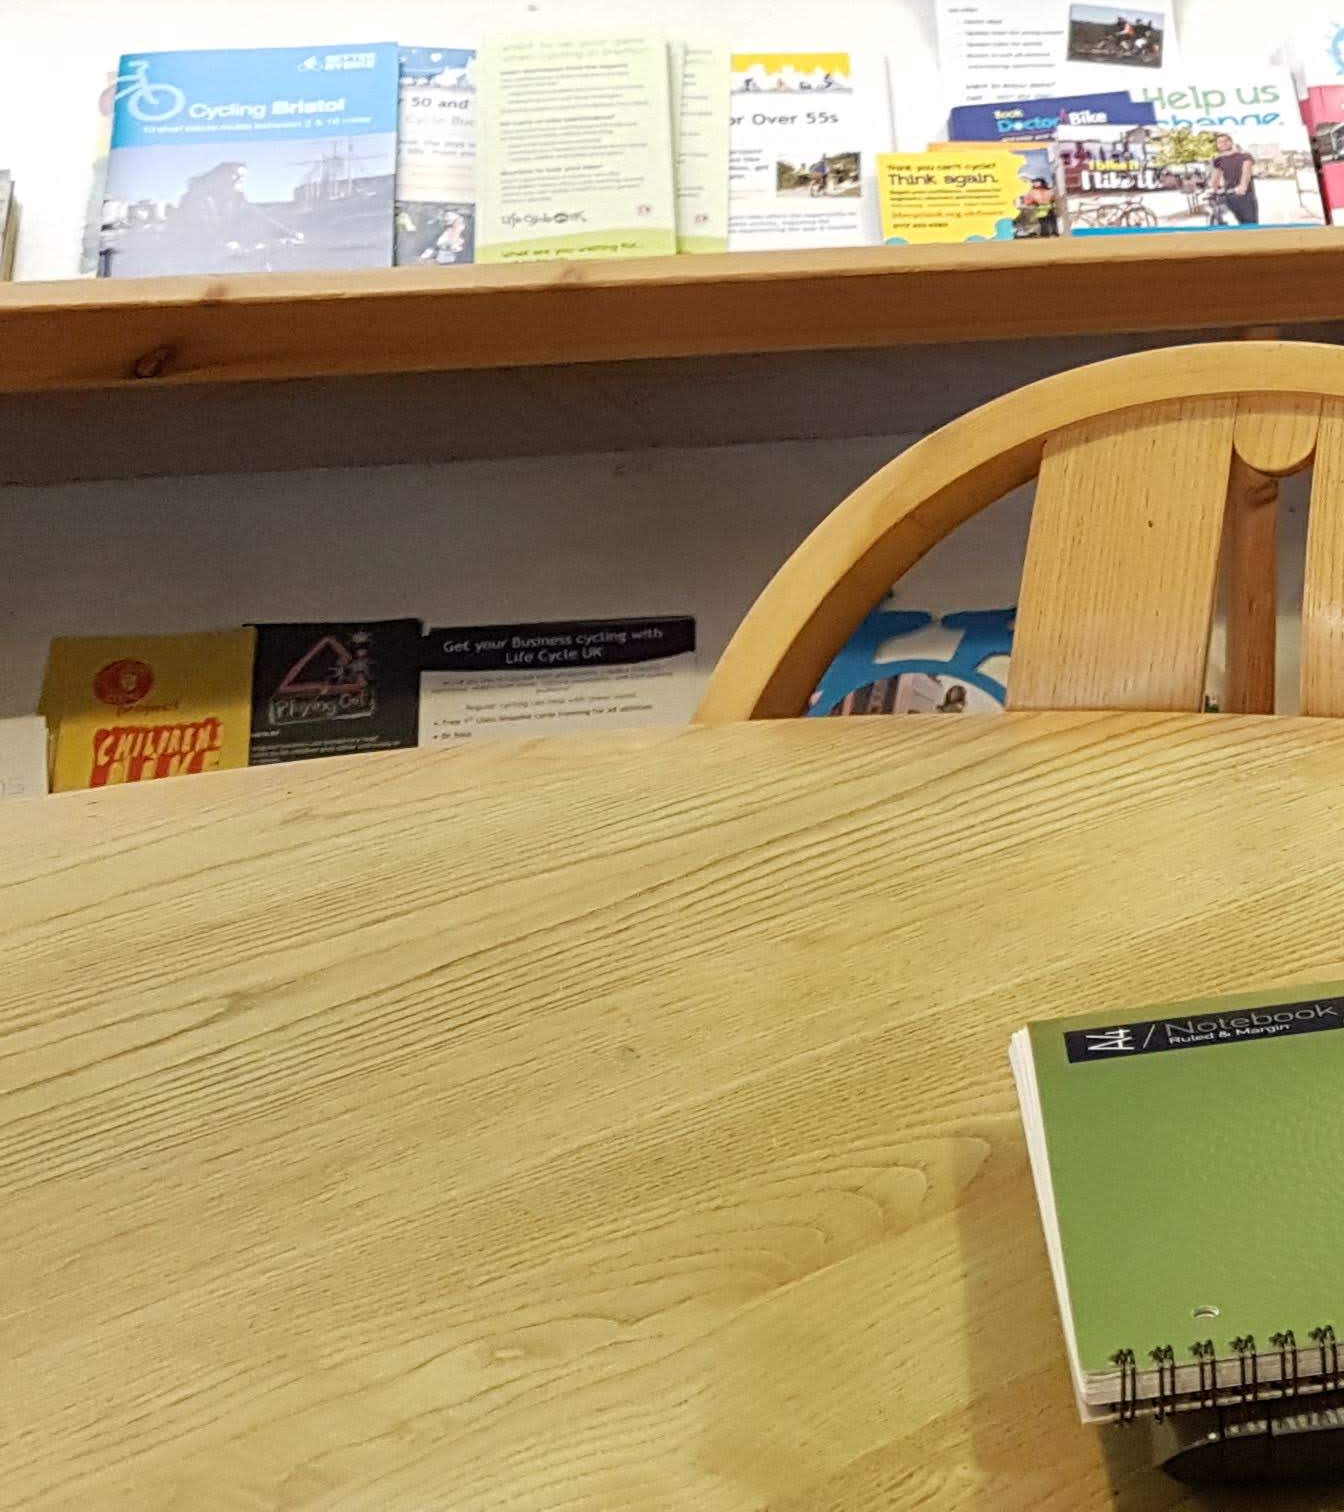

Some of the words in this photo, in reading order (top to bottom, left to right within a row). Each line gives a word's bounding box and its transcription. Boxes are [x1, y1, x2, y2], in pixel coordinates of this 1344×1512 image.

[188, 102, 266, 120] Cycling
[271, 97, 346, 116] Bristol
[411, 96, 432, 108] 50
[438, 99, 469, 109] and
[1142, 86, 1226, 116] Help
[1236, 85, 1280, 105] us
[751, 112, 798, 126] Over
[805, 111, 839, 125] 55s
[1068, 109, 1108, 126] Bike
[888, 173, 937, 185] Think
[443, 639, 471, 653] Get
[474, 639, 507, 654] your
[511, 633, 573, 648] Business
[575, 630, 627, 646] cycling
[631, 628, 663, 639] with
[506, 650, 534, 664] Life
[537, 649, 578, 664] Cycle
[582, 646, 603, 659] UK
[1163, 1003, 1338, 1037] Notebook
[1086, 1028, 1135, 1051] A4
[1168, 1030, 1215, 1045] Ruled
[1218, 1030, 1231, 1039] &
[1236, 1023, 1291, 1037] Margin
